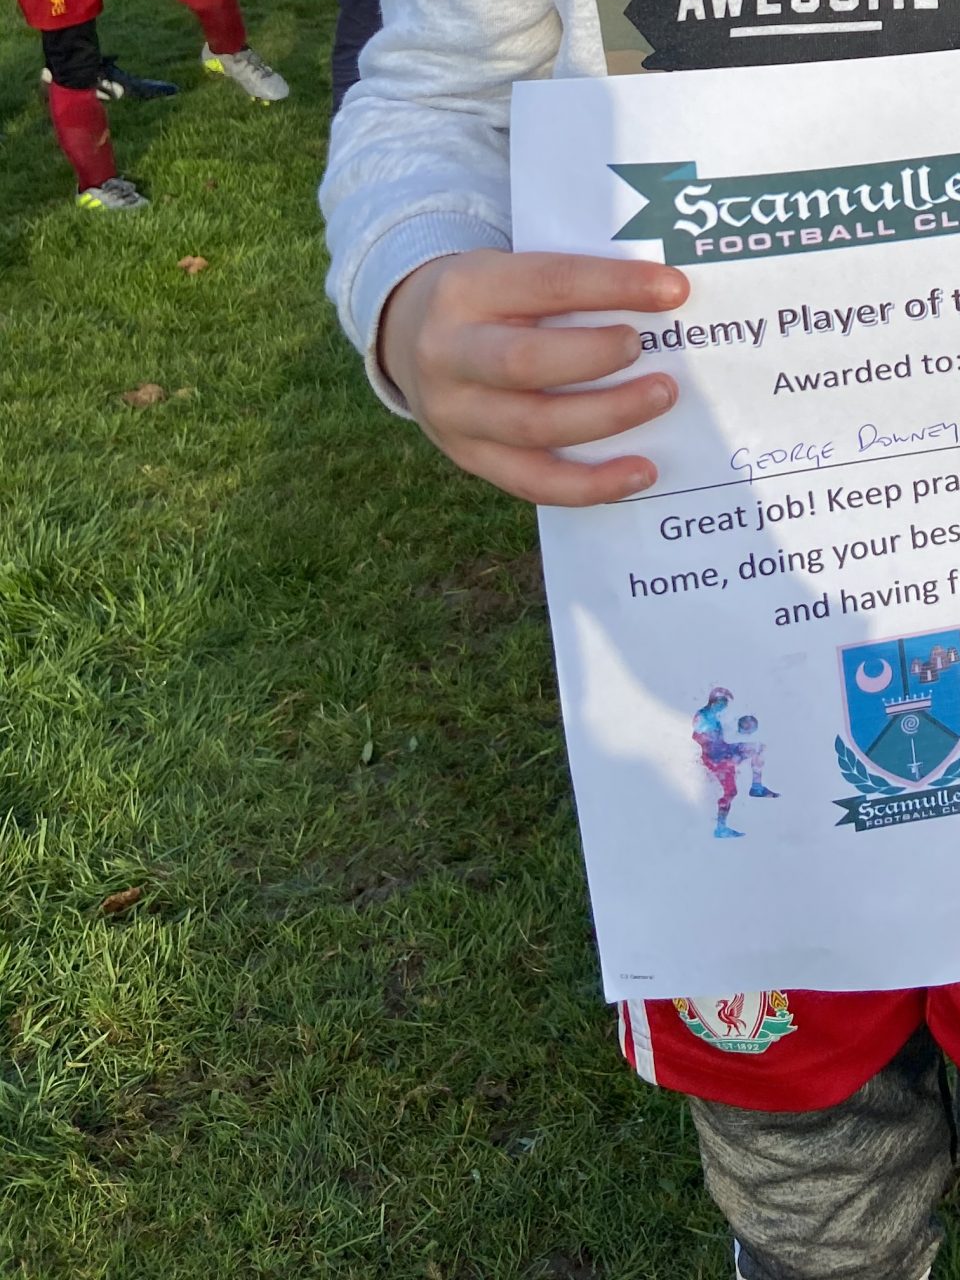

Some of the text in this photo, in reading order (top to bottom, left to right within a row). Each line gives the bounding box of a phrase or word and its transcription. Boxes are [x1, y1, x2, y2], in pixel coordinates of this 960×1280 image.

[695, 219, 896, 257] FOOTBALL
[640, 318, 767, 353] ademy
[777, 301, 895, 336] Player
[904, 288, 943, 322] of
[772, 354, 912, 395] Awarded
[730, 442, 835, 486] GEORGE
[659, 506, 748, 541] Great
[755, 490, 816, 531] job!
[827, 482, 902, 512] Keep
[628, 566, 729, 598] home,
[738, 548, 825, 581] doing
[832, 533, 902, 569] your
[773, 592, 831, 626] and
[840, 578, 940, 614] having
[865, 810, 936, 828] FOOTBALL
